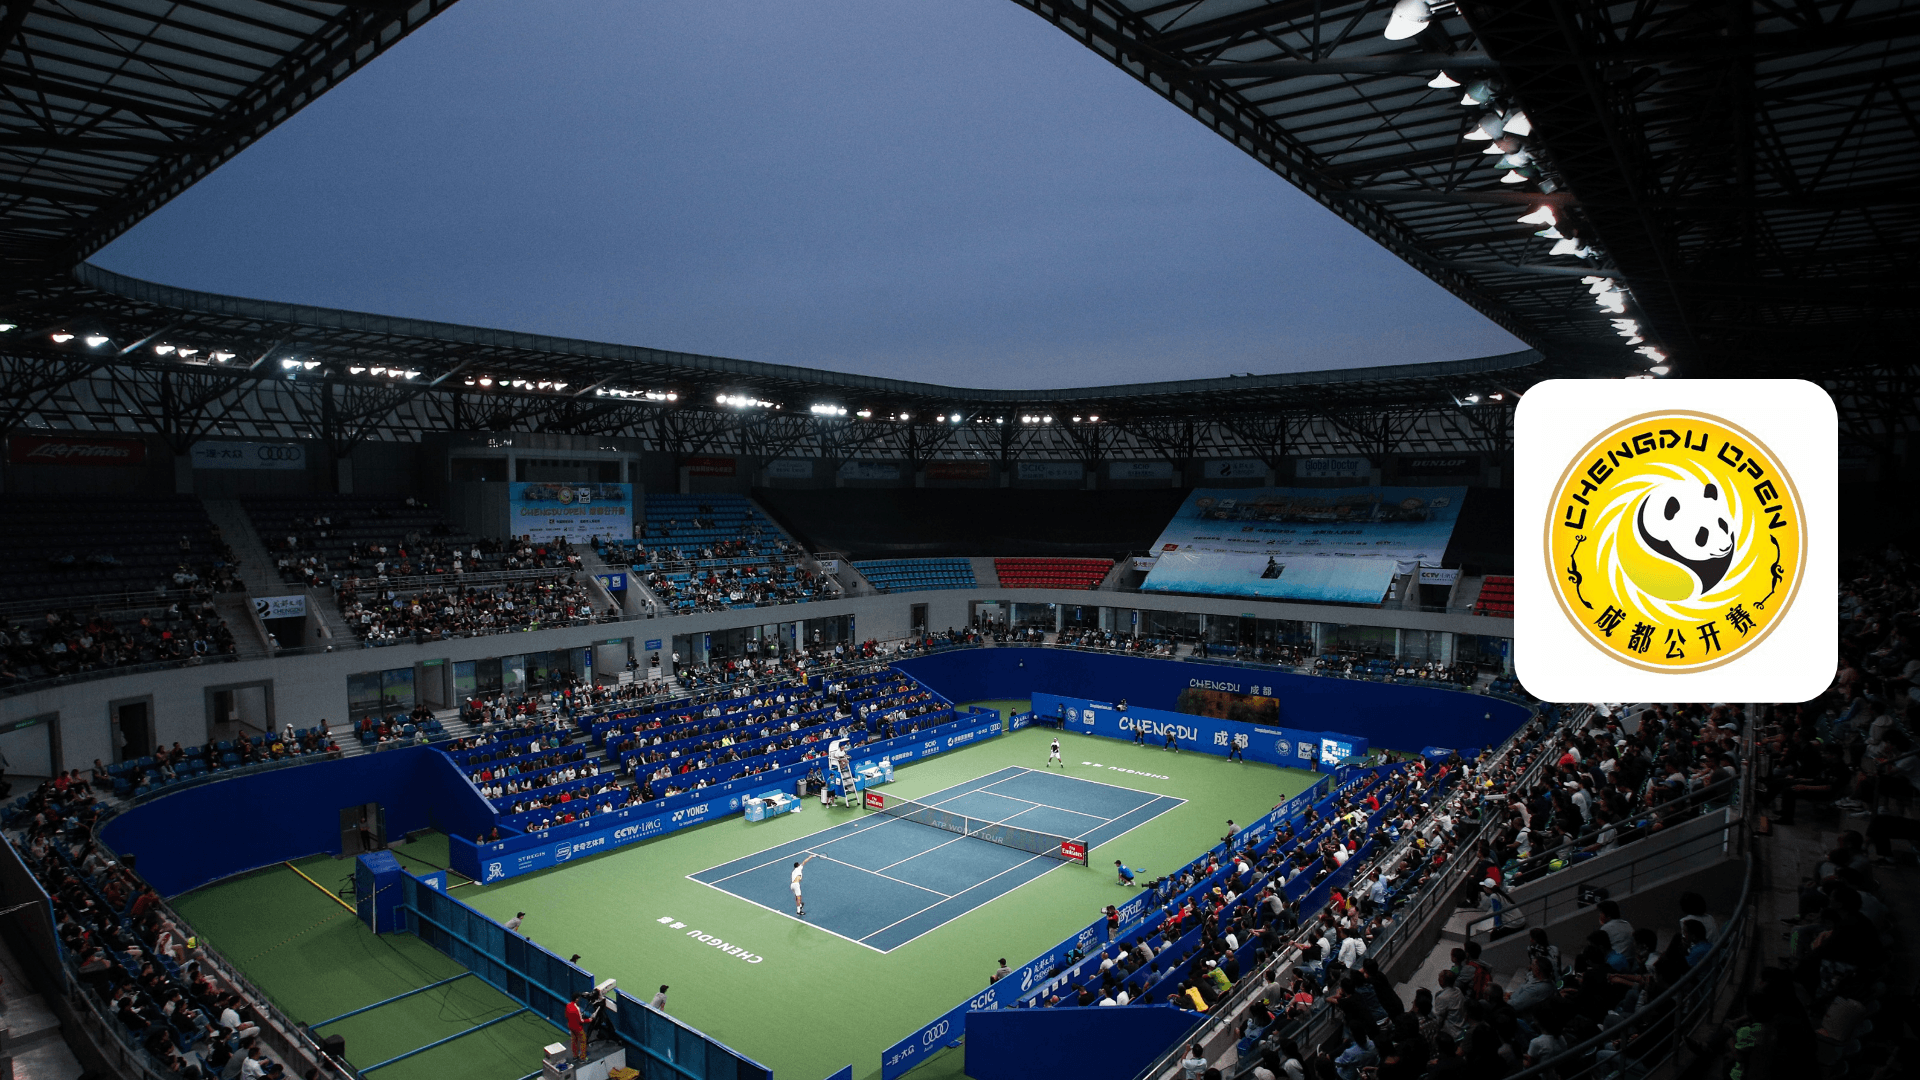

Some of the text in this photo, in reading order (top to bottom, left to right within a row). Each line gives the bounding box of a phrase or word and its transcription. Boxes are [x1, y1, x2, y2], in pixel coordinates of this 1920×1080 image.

[1021, 464, 1046, 472] SCIG
[1305, 459, 1358, 471] Global Doctor
[1411, 459, 1466, 467] DUNLOP
[520, 506, 586, 516] CHENGDU OPEN
[1189, 678, 1240, 693] CHENGDU
[1250, 685, 1272, 697] 成都
[1119, 716, 1198, 742] CHENGDU
[1213, 730, 1249, 750] 成都
[686, 803, 709, 818] YONEX
[931, 820, 1005, 845] ATP WOLD TOUR
[1079, 927, 1094, 943] SCIG
[686, 930, 763, 963] CHENGDU
[971, 989, 996, 1011] SCIG
